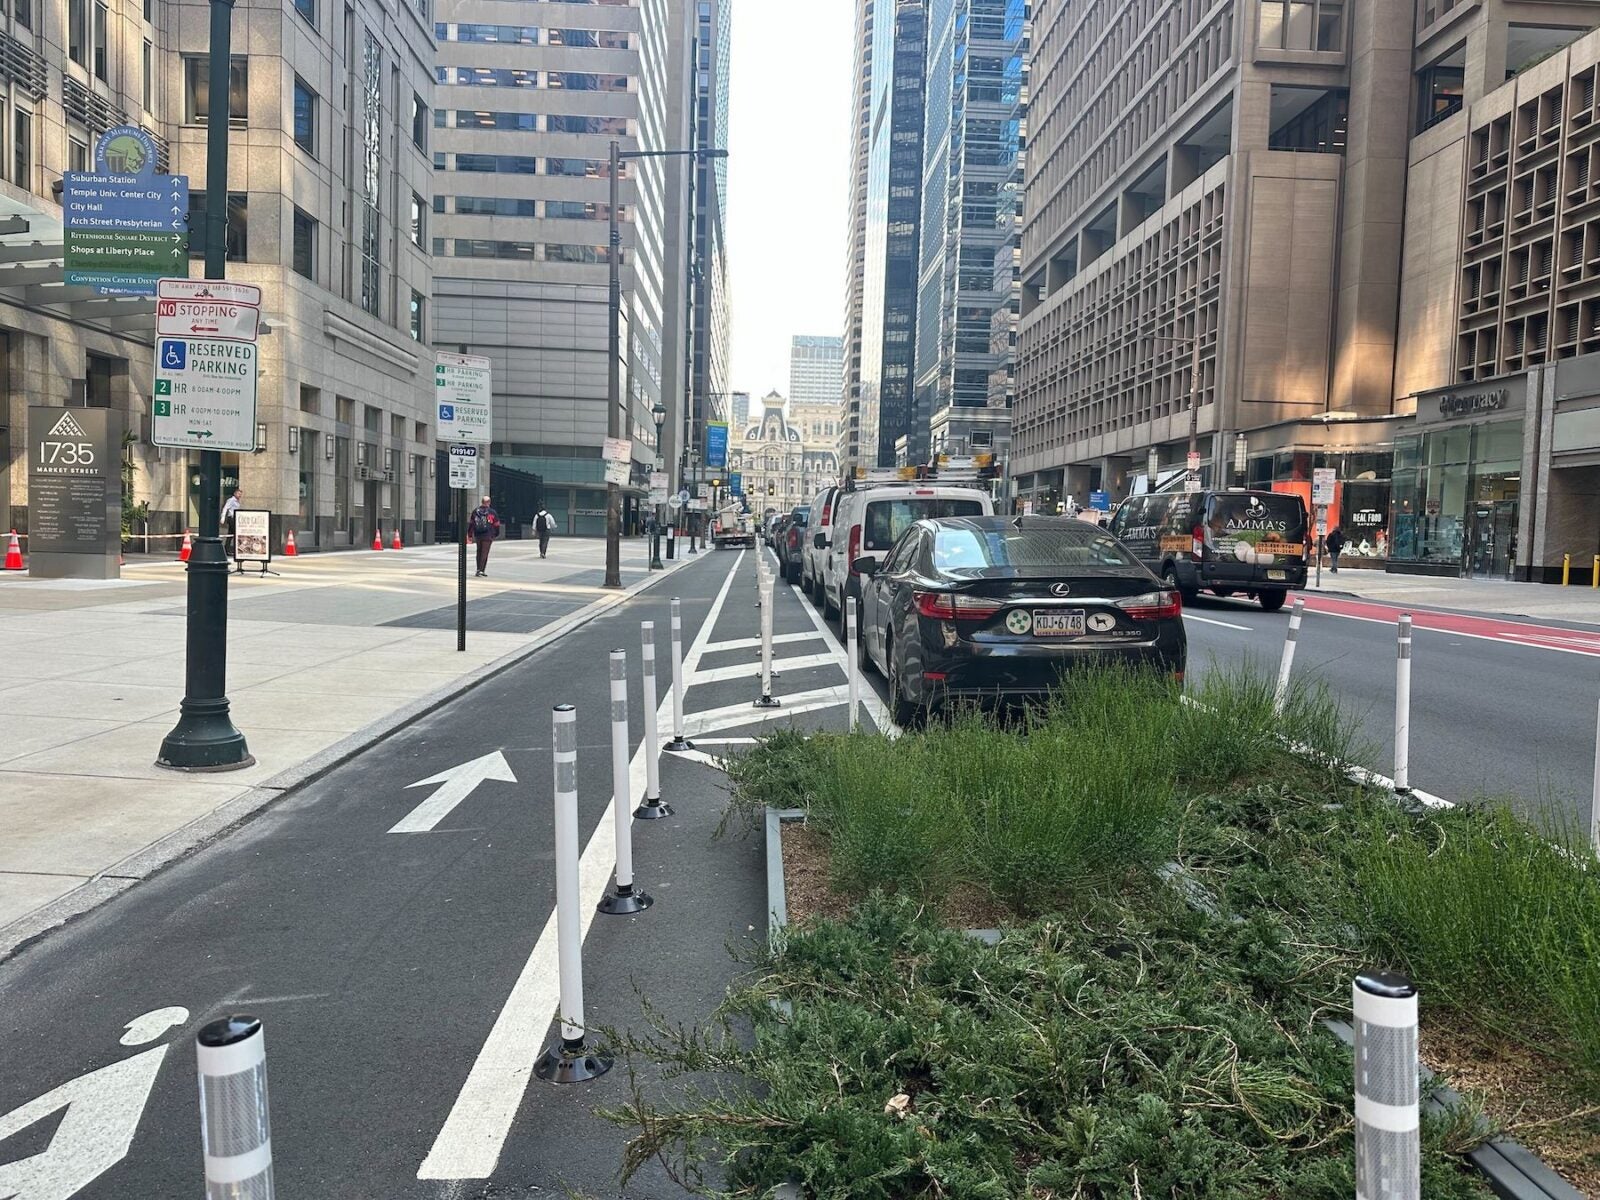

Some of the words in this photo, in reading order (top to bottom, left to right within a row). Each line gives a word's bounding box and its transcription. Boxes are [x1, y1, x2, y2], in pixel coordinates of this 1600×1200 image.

[70, 174, 107, 183] Suburban
[109, 176, 136, 184] Station
[70, 188, 96, 198] Temple
[100, 189, 118, 198] Univ.
[120, 190, 144, 199] Center
[146, 191, 161, 200] City
[70, 203, 85, 212] City
[115, 219, 162, 230] Presbyterian
[71, 232, 113, 241] RITTENHOUSE
[115, 233, 137, 242] SQUARE
[139, 234, 168, 242] DISTRICT
[71, 245, 94, 255] Shops
[106, 246, 132, 257] Liberty
[134, 247, 155, 256] Place
[71, 275, 111, 283] CONVENTION
[112, 276, 136, 284] CENTER
[160, 304, 175, 316] NO
[180, 305, 238, 318] STOPPING
[189, 343, 251, 360] RESERVED
[192, 360, 247, 376] PARKING
[458, 369, 483, 378] PARKING
[160, 382, 166, 392] 2
[174, 383, 187, 394] HR
[458, 382, 483, 390] PARKING
[160, 403, 166, 413] 3
[174, 404, 186, 414] HR
[455, 406, 488, 416] RESERVED
[457, 416, 487, 424] PARKING
[40, 442, 94, 465] 1735
[645, 464, 651, 473] P
[1353, 513, 1366, 522] REAL
[1368, 513, 1382, 522] FOOD
[1226, 518, 1286, 531] AMMA'S
